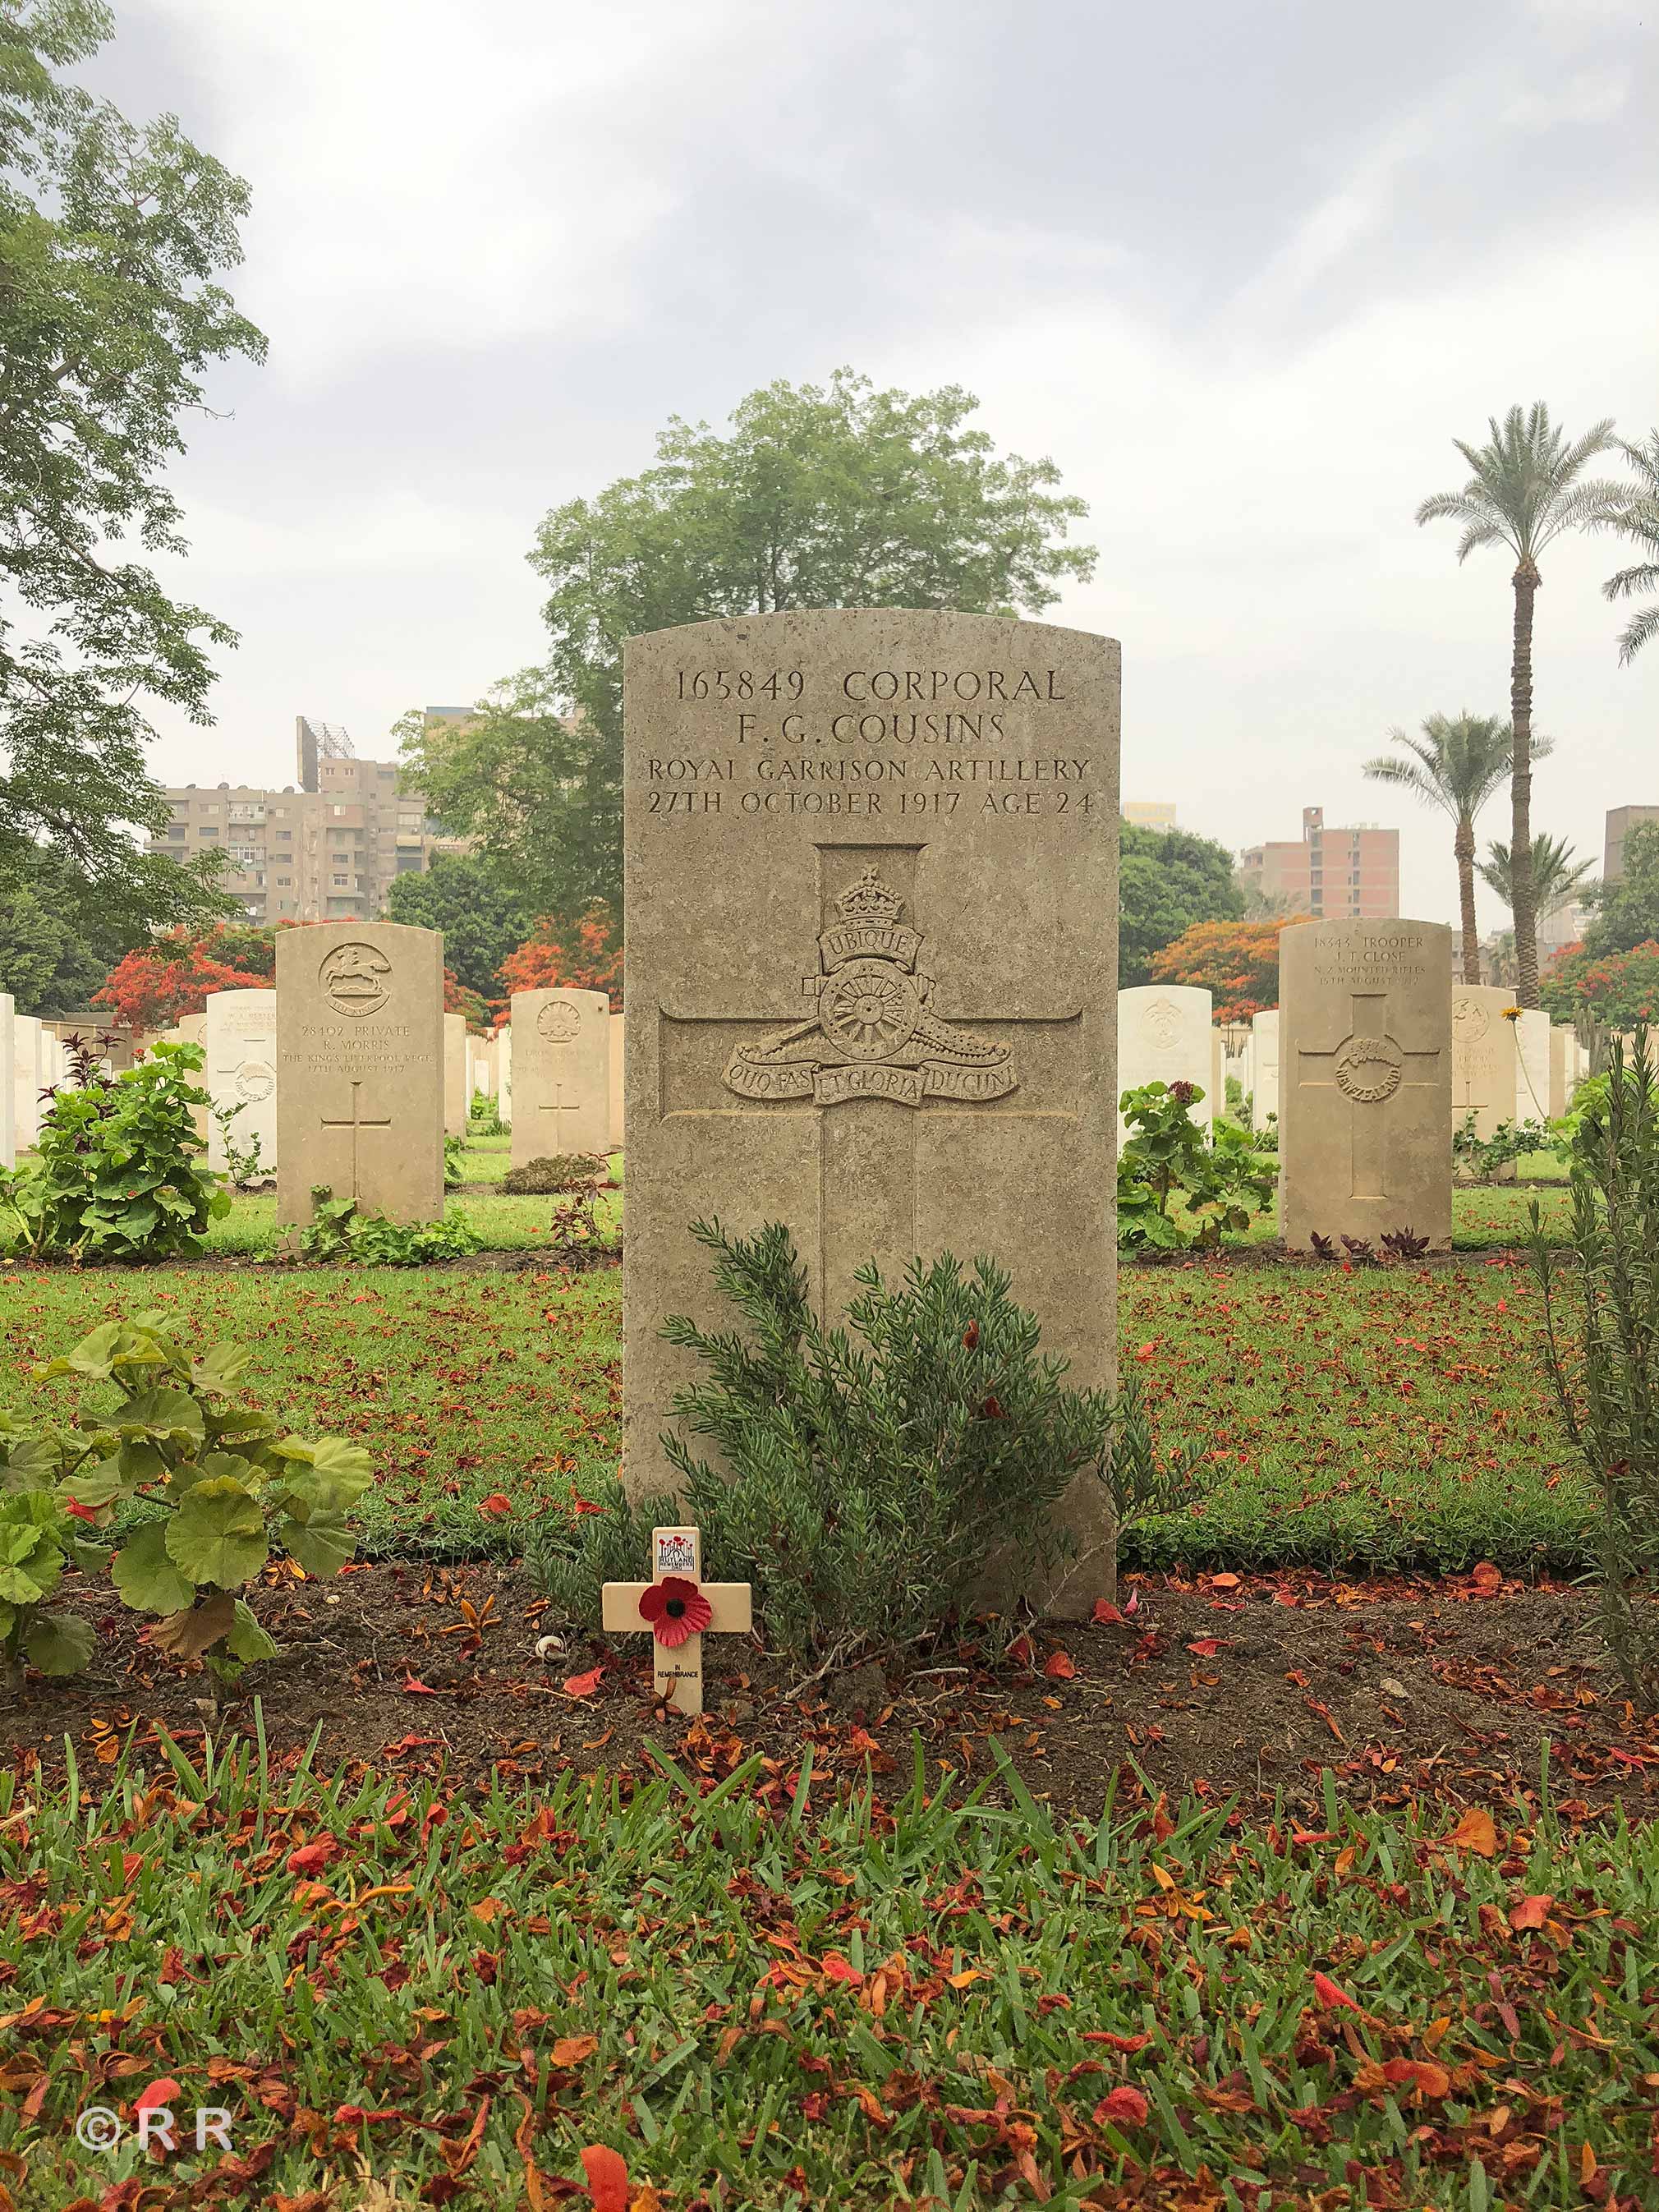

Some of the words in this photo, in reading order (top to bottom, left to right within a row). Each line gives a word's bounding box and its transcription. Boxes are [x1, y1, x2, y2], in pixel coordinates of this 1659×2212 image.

[677, 669, 807, 702] 165849
[842, 669, 1067, 702] CORPORAL
[647, 758, 738, 783] ROYAL
[757, 758, 908, 783] GARRISON
[926, 758, 1092, 783] ARTILLERY
[647, 791, 723, 815] 27TH
[741, 791, 883, 815] OCTOBER
[900, 791, 961, 815] 1917
[979, 791, 1041, 815] AGE
[1055, 791, 1095, 815] 24
[829, 930, 910, 954] UBIQUE
[1363, 937, 1423, 948] TROOPER
[1363, 951, 1406, 963] CLOSE
[355, 1026, 411, 1037] PRIVATE
[341, 1040, 389, 1051] MORRIS
[283, 1054, 303, 1063] THE
[777, 1069, 810, 1092] FAS
[820, 1075, 842, 1098] ET
[848, 1070, 918, 1099] GLORIA
[931, 1065, 1013, 1093] DUCUNT
